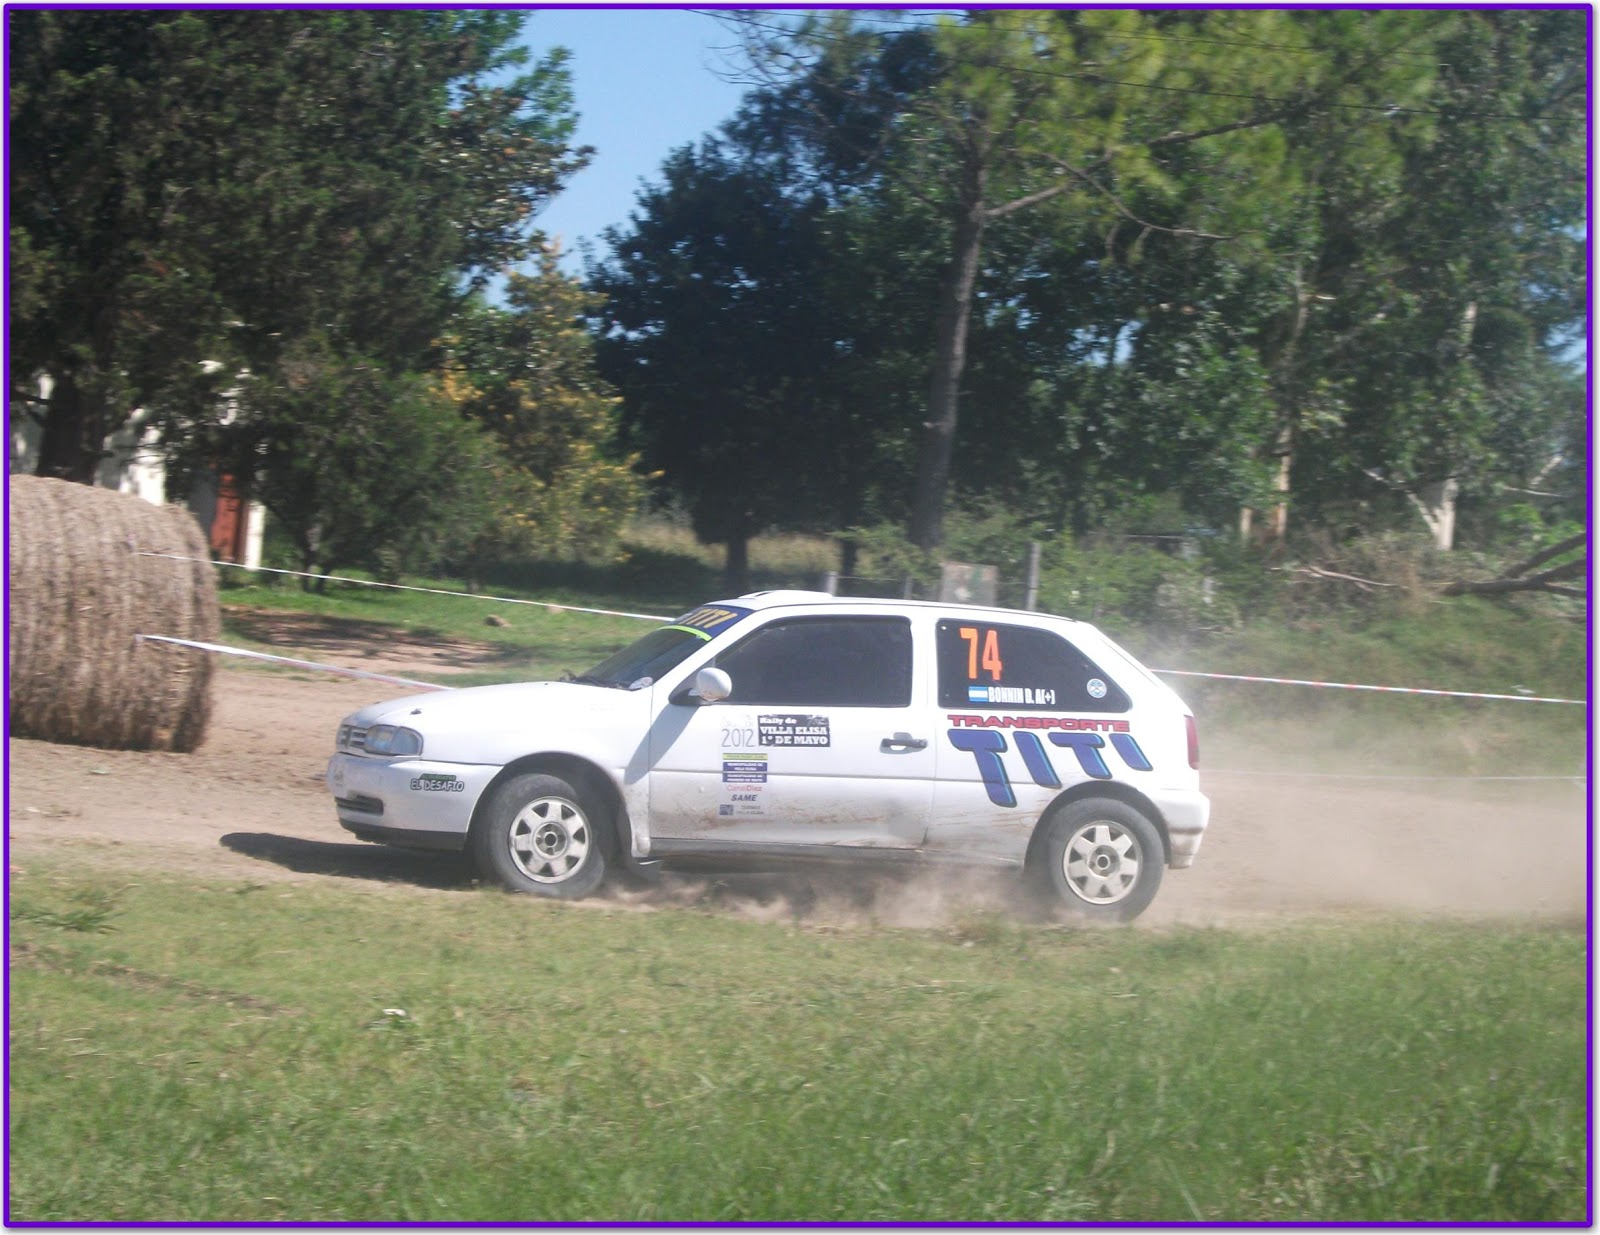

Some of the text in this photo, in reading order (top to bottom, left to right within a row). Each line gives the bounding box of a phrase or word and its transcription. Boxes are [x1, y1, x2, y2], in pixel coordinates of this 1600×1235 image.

[960, 628, 1002, 681] 74
[988, 686, 1024, 704] BONNIN
[759, 717, 785, 725] Rally
[947, 714, 1130, 732] TRANSPORTE
[721, 729, 755, 747] 2012
[760, 726, 827, 735] VILLA ELISA
[775, 736, 792, 745] DE
[794, 736, 828, 745] MAYO
[947, 728, 1154, 808] TITI
[410, 778, 465, 792] EL DESAFIO
[731, 794, 757, 802] SAME
